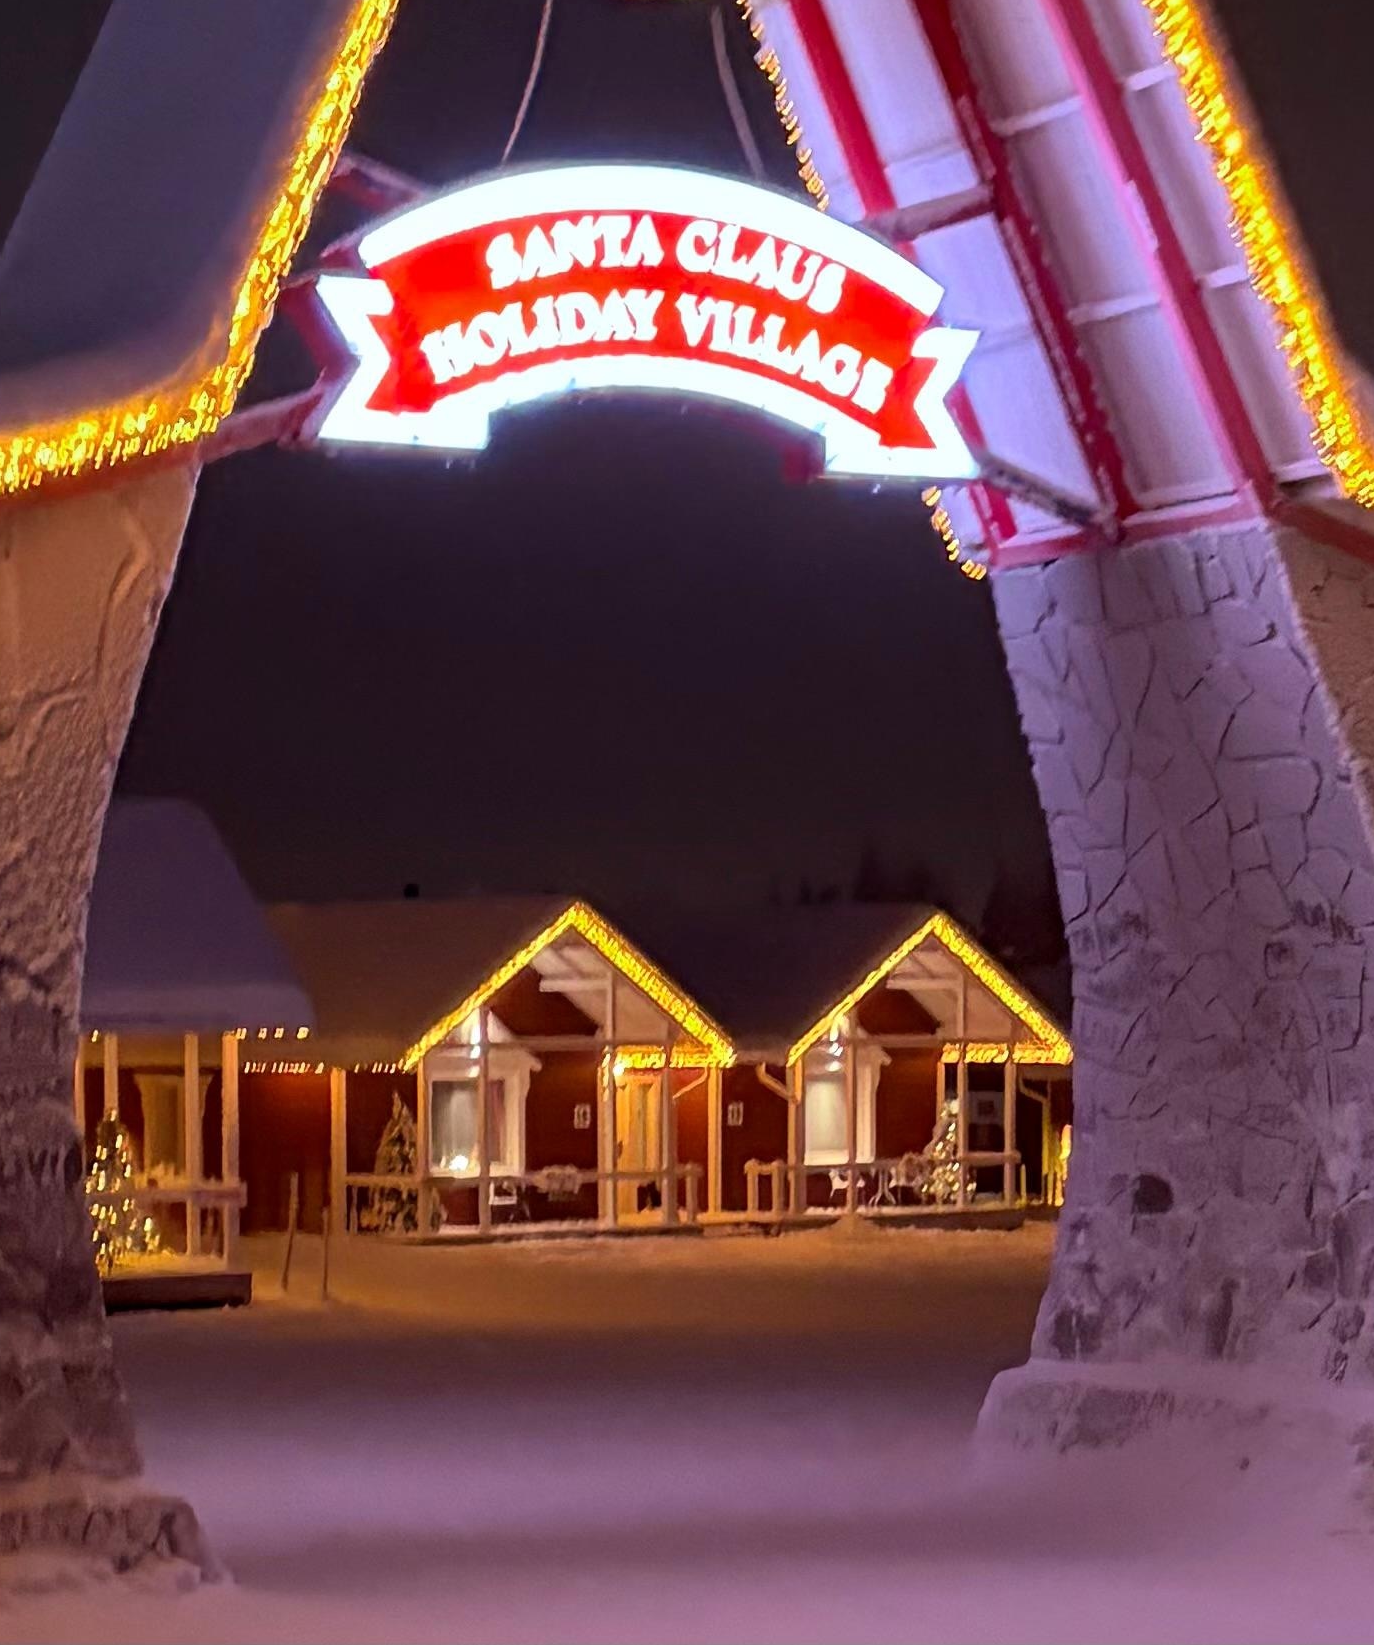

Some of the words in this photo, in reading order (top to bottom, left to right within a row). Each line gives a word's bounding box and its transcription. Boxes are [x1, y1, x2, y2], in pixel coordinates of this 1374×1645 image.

[486, 214, 665, 290] SANTA
[676, 219, 847, 314] CLAUS
[420, 289, 665, 384] HOLIDAY
[675, 293, 894, 414] VILLAGE
